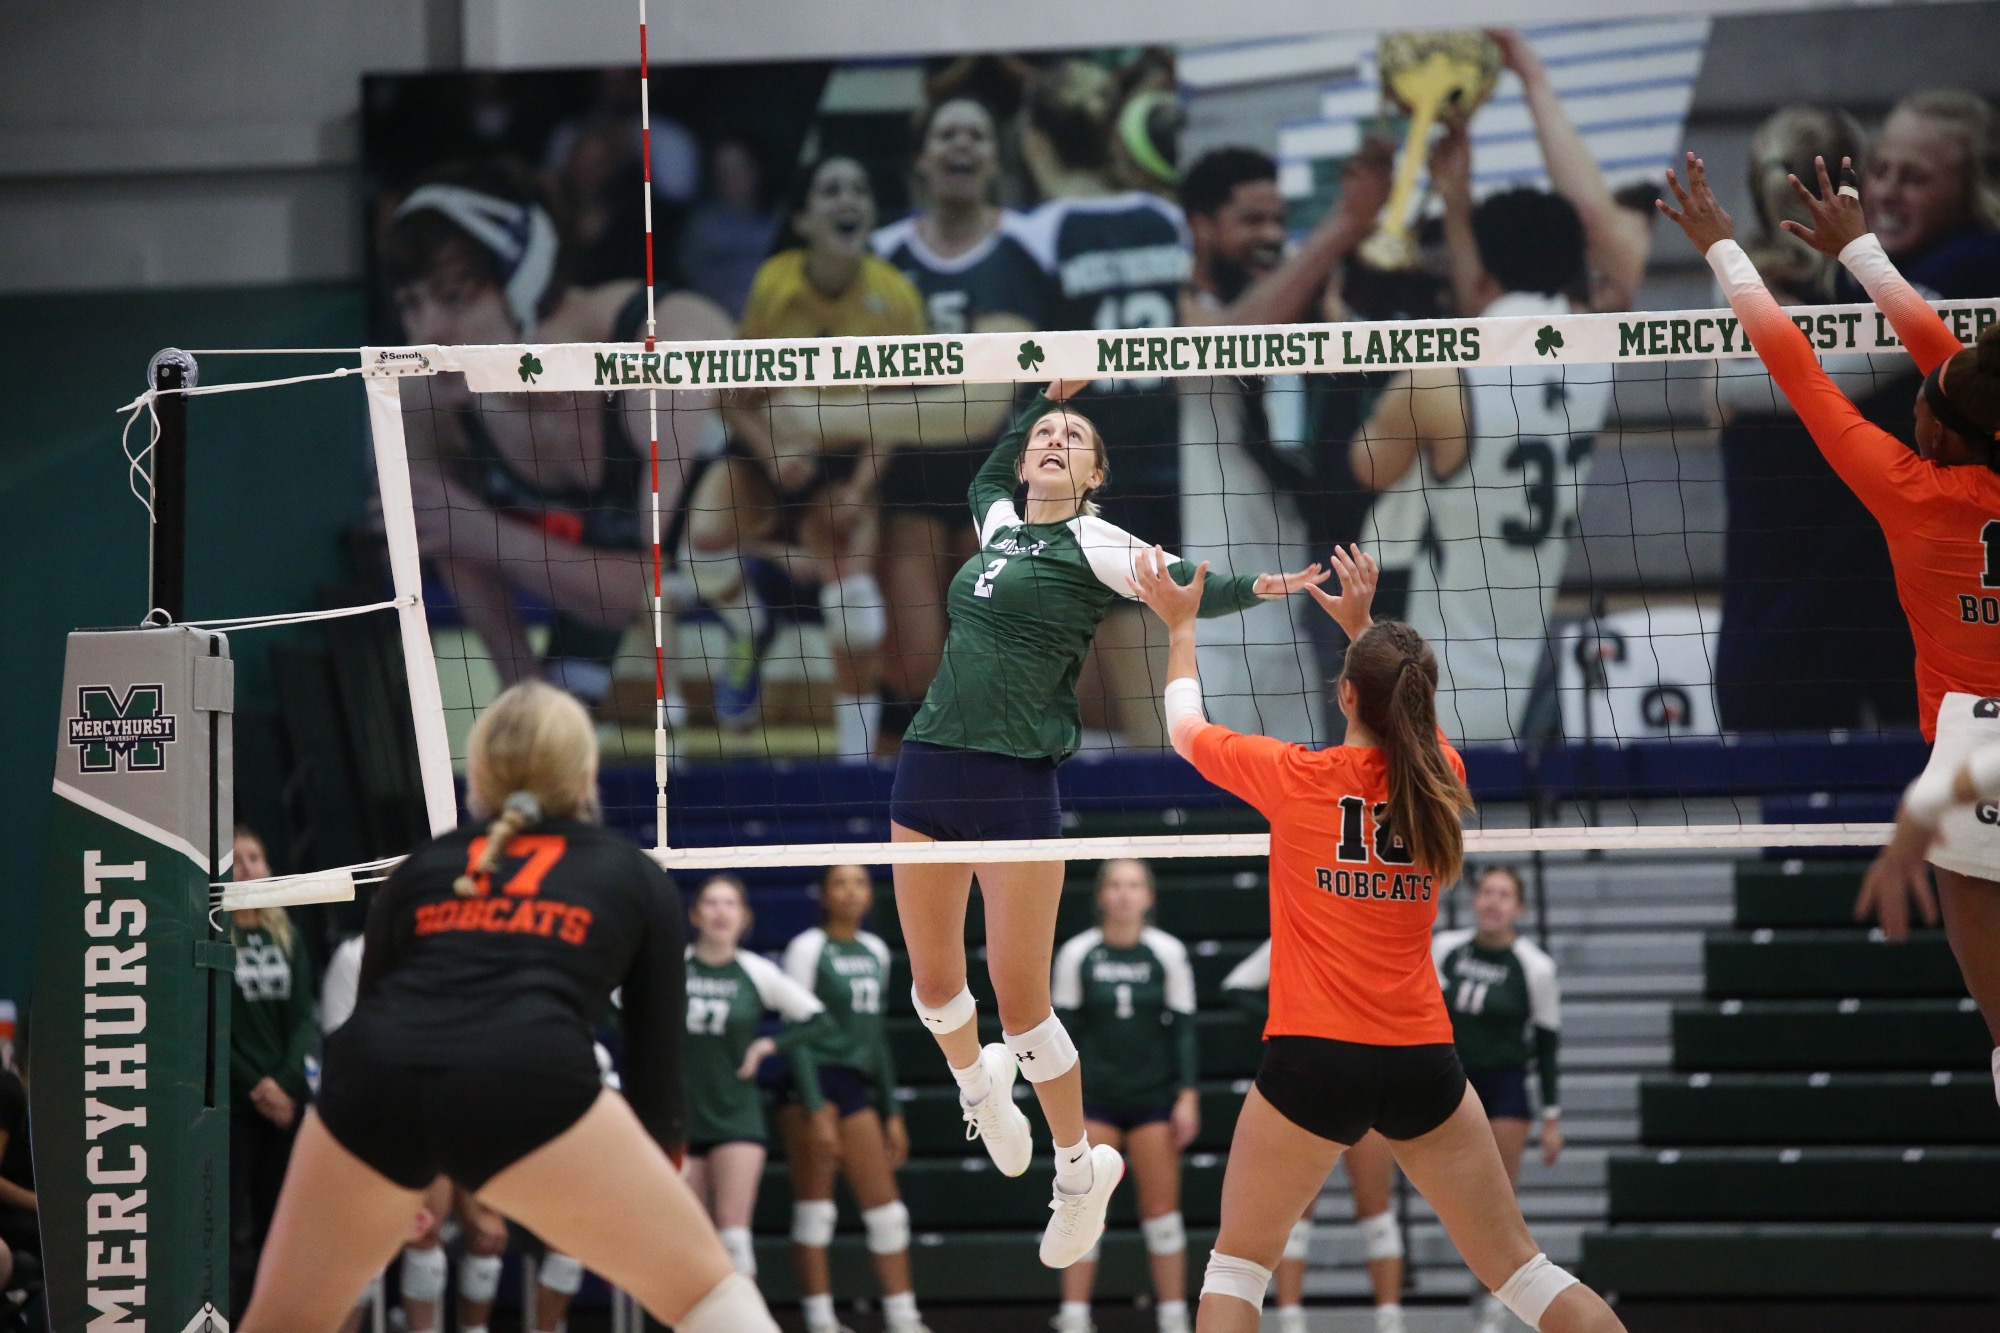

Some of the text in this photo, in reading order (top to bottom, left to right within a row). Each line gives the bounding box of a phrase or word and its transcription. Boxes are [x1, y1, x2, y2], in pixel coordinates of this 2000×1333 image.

[1097, 327, 1480, 371] MERCYHURST LAKERS
[1618, 313, 1862, 356] MERCYRST
[389, 352, 421, 360] Senoh
[594, 341, 964, 386] MERCYHURST LAKERS
[973, 558, 1008, 599] 2
[72, 719, 173, 736] MERCYHURST
[104, 735, 139, 743] UNIVERSITY
[1316, 867, 1433, 902] BOBCATS
[415, 897, 592, 945] BOBCATS
[84, 850, 148, 1333] MERCYHURST
